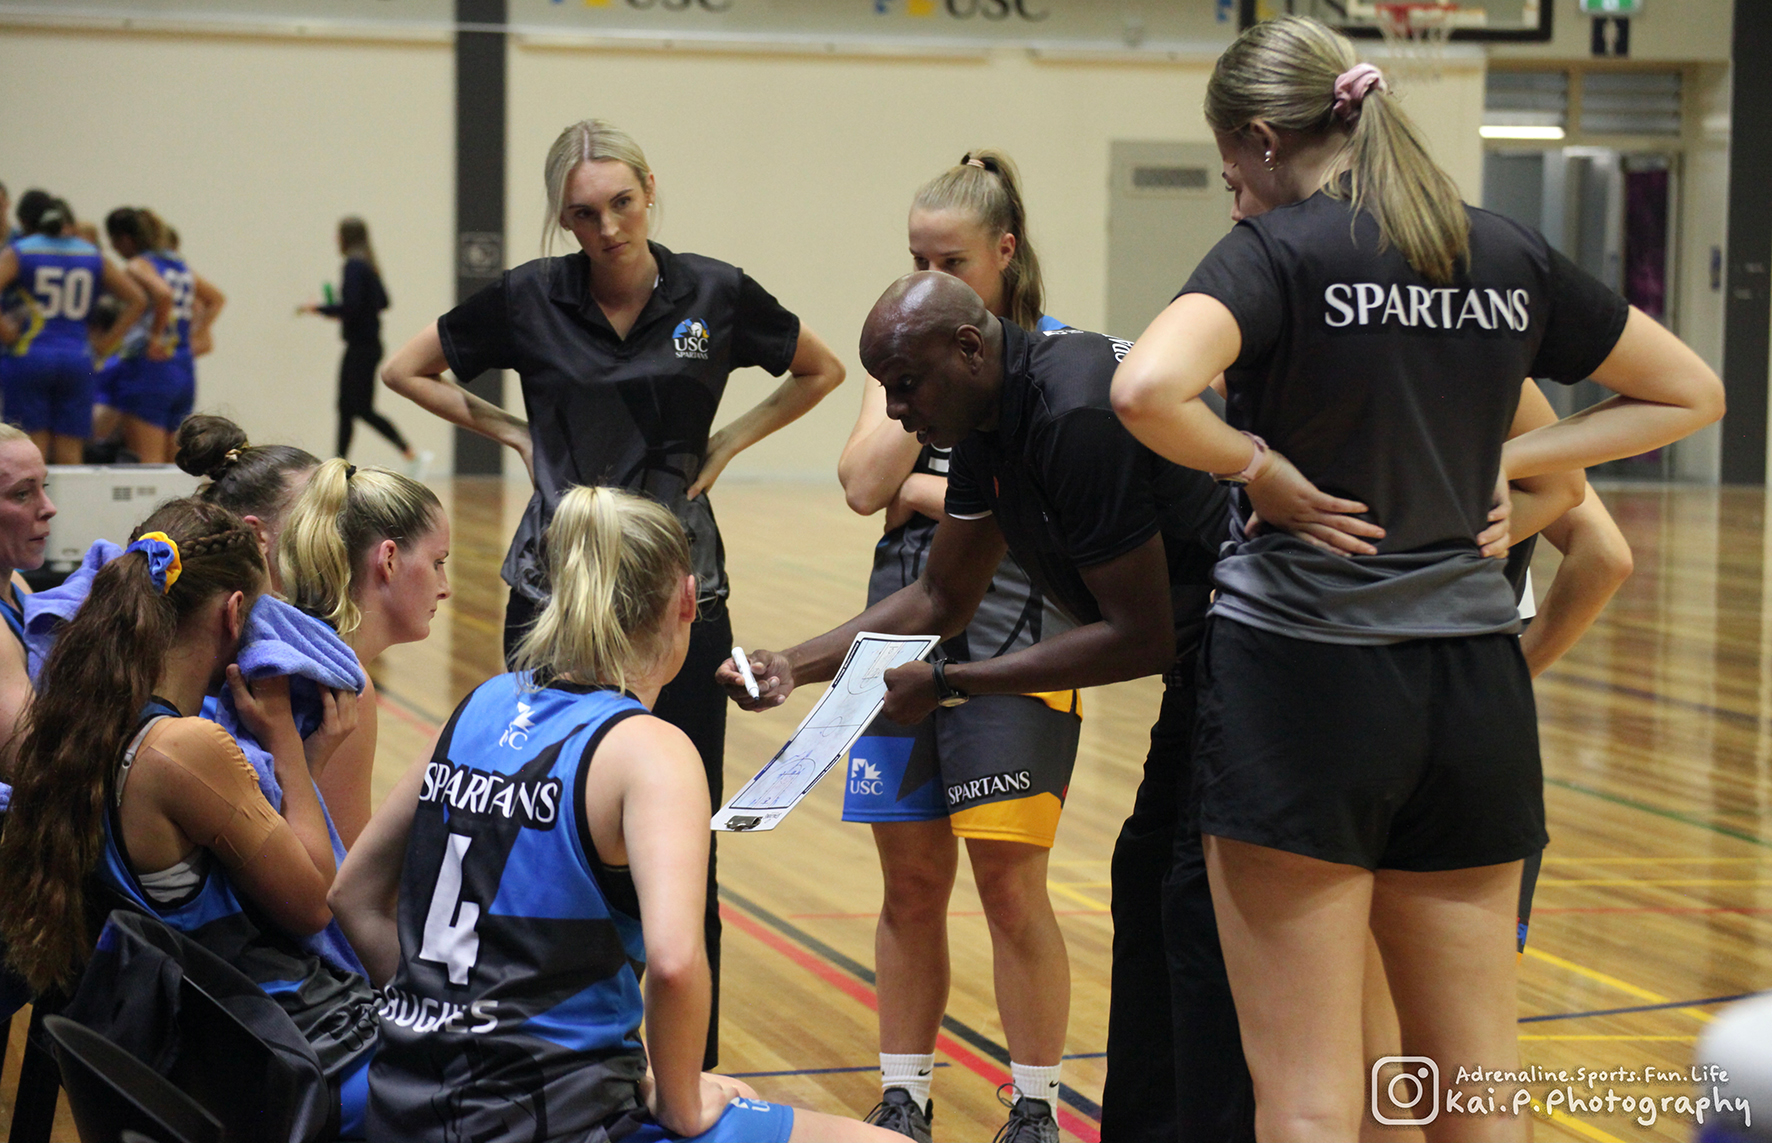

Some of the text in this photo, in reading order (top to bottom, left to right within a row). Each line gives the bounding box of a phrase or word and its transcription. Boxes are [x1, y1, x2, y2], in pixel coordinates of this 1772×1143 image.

[35, 266, 94, 320] 50
[1324, 283, 1530, 332] SPARTANS
[673, 336, 709, 353] USC
[675, 351, 709, 360] SPARTANS
[418, 761, 558, 823] SPARTANS
[850, 780, 884, 796] USC
[948, 771, 1031, 805] SPARTANS
[419, 833, 480, 985] 4
